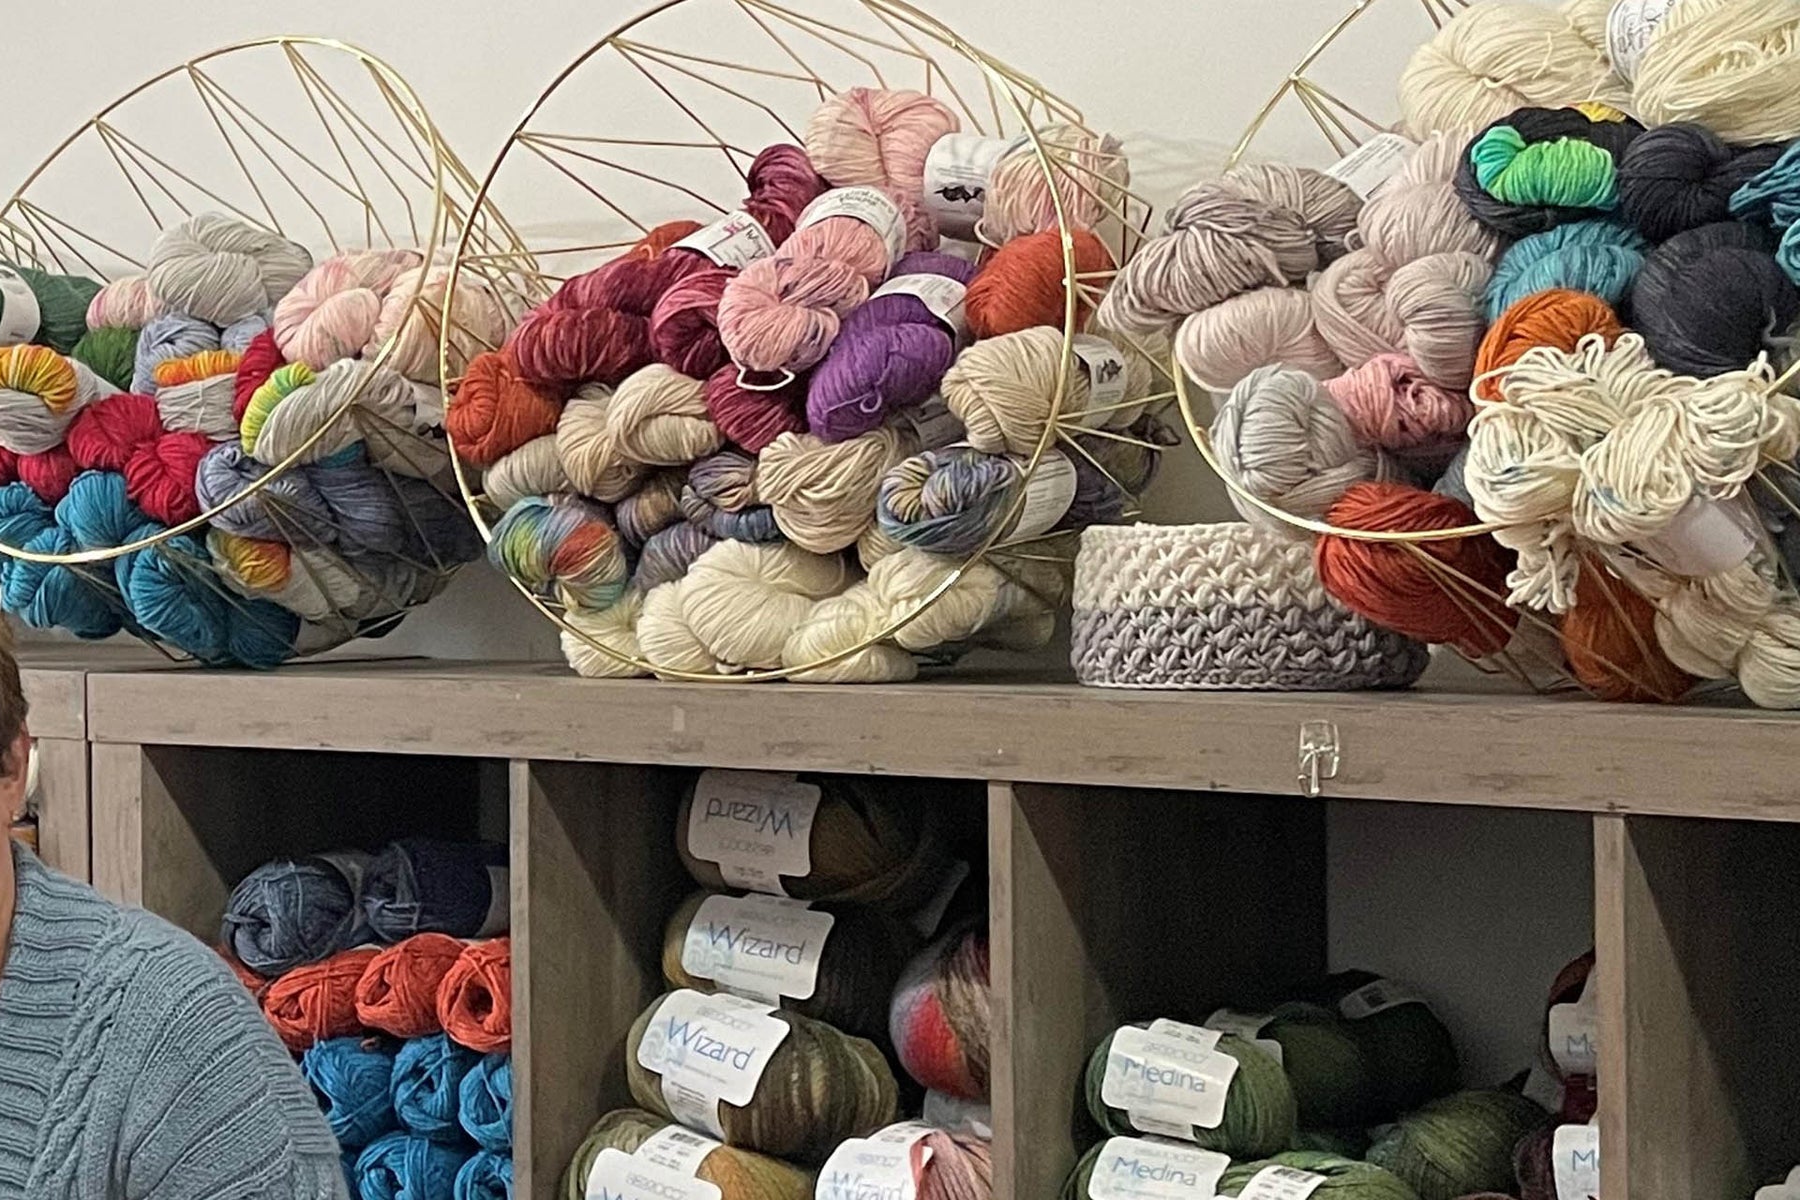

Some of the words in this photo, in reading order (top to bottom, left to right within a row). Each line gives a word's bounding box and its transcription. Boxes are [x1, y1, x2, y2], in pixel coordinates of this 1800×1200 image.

[706, 797, 793, 839] Wizard
[708, 921, 806, 965] Wizard
[667, 1016, 756, 1071] Wizard
[1123, 1057, 1206, 1093] Medina
[1112, 1156, 1197, 1187] Medina
